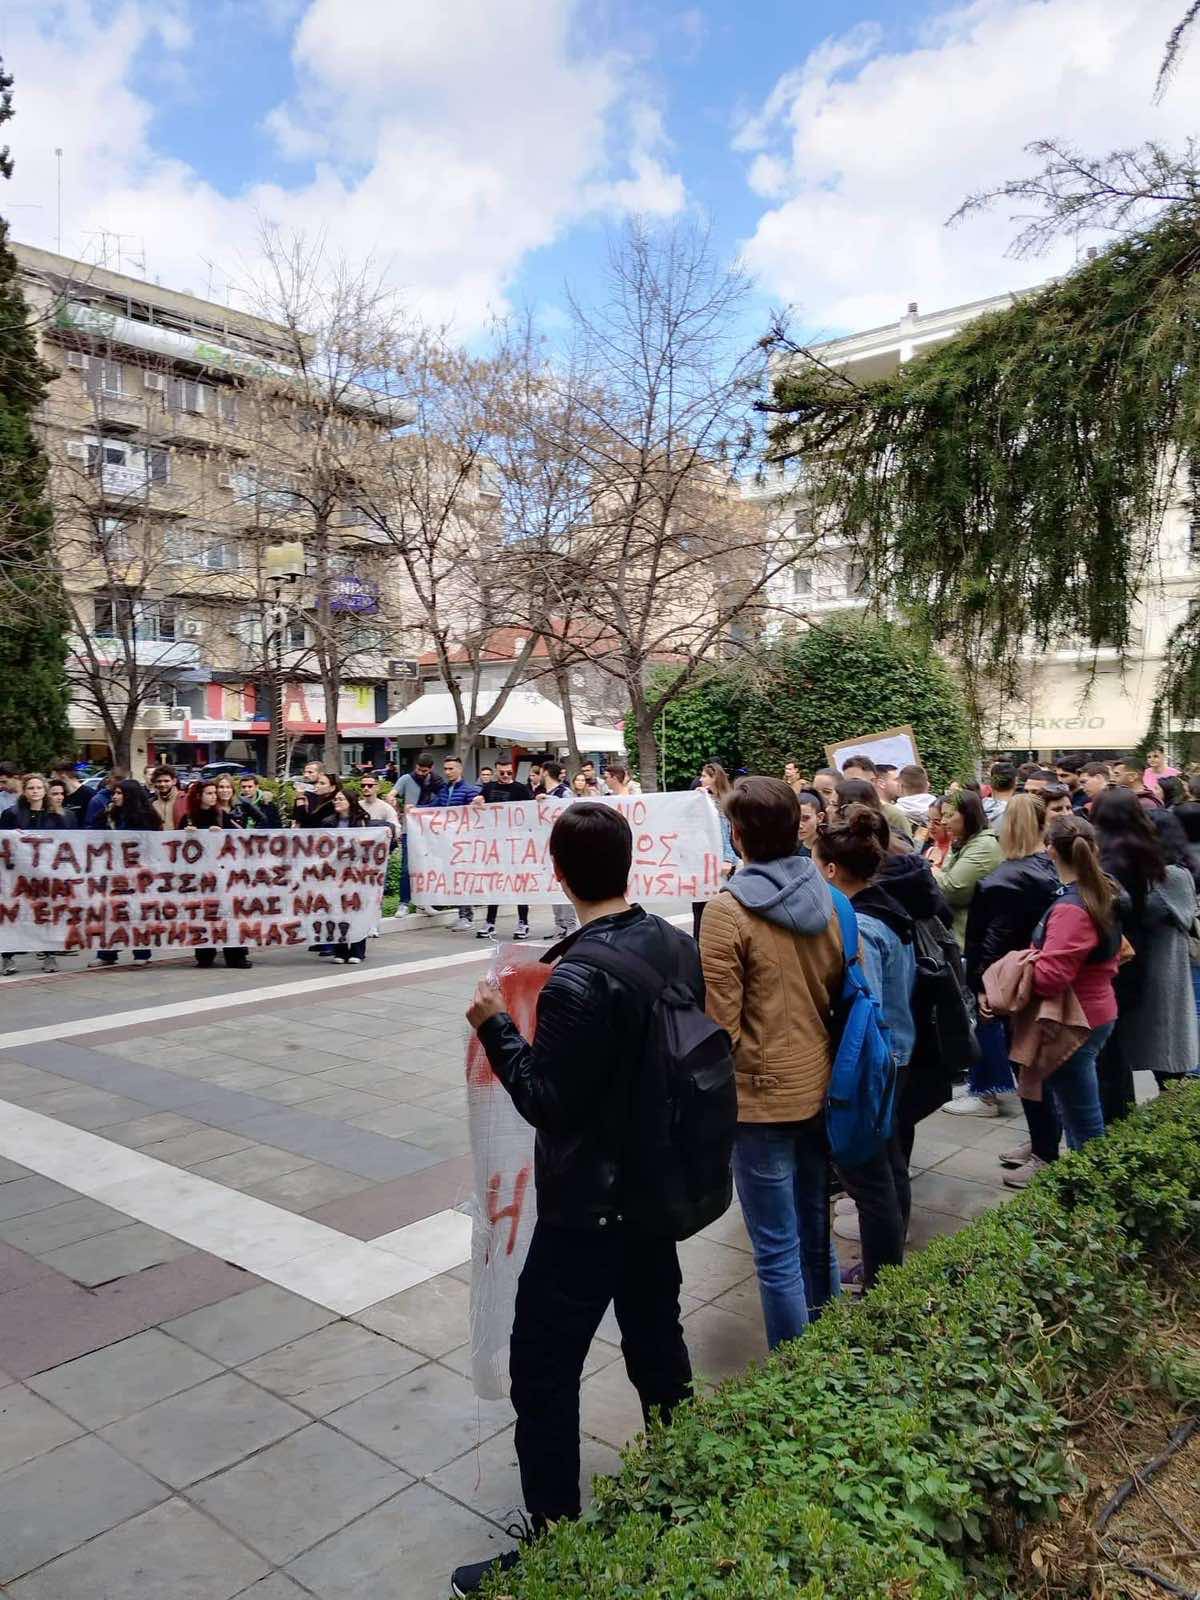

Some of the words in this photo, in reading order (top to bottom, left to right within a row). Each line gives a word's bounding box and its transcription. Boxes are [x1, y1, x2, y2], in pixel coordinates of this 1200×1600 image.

[416, 806, 525, 836] ΤΕΡΑΣΤΙΟ
[162, 840, 203, 864] ΤΟ
[216, 834, 388, 865] ΑΥΤΟΝΟΗΤΟ
[302, 861, 337, 882] ΜΑ
[32, 901, 130, 926] ΕΓΙΝΕ
[140, 900, 221, 922] ΠΟΤΕ
[232, 896, 282, 919] ΚΑΙ
[292, 893, 331, 915] ΝΑ
[340, 892, 361, 912] Η
[64, 922, 228, 950] ΑΠΑΝΤΗΣΗ
